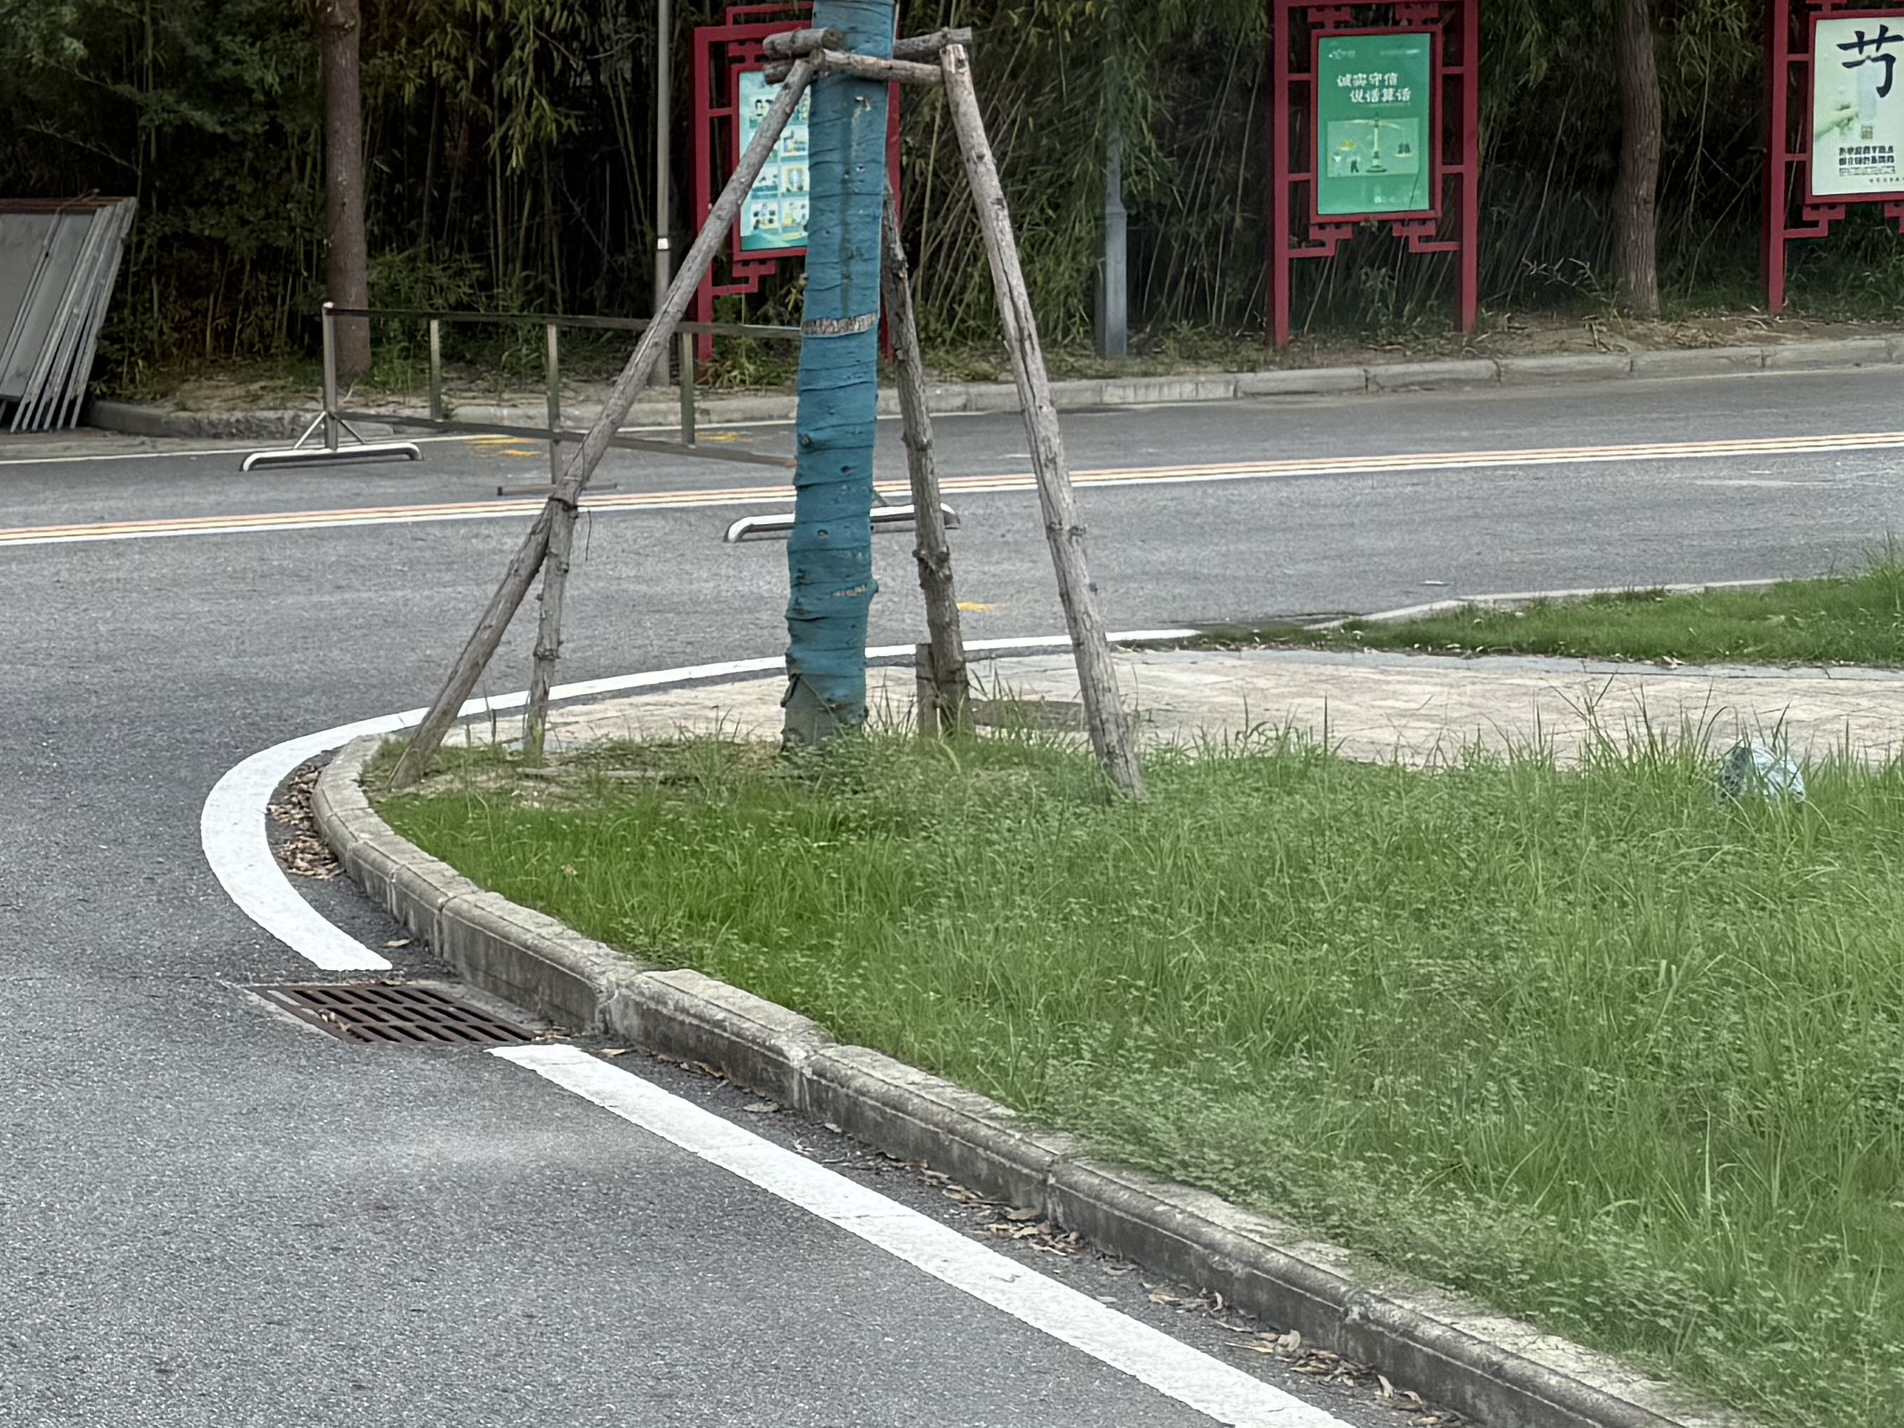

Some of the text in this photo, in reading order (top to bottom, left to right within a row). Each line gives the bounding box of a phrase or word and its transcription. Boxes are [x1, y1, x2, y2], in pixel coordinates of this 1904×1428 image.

[1337, 72, 1398, 87] 诚实守信
[1350, 88, 1411, 102] 说话算话
